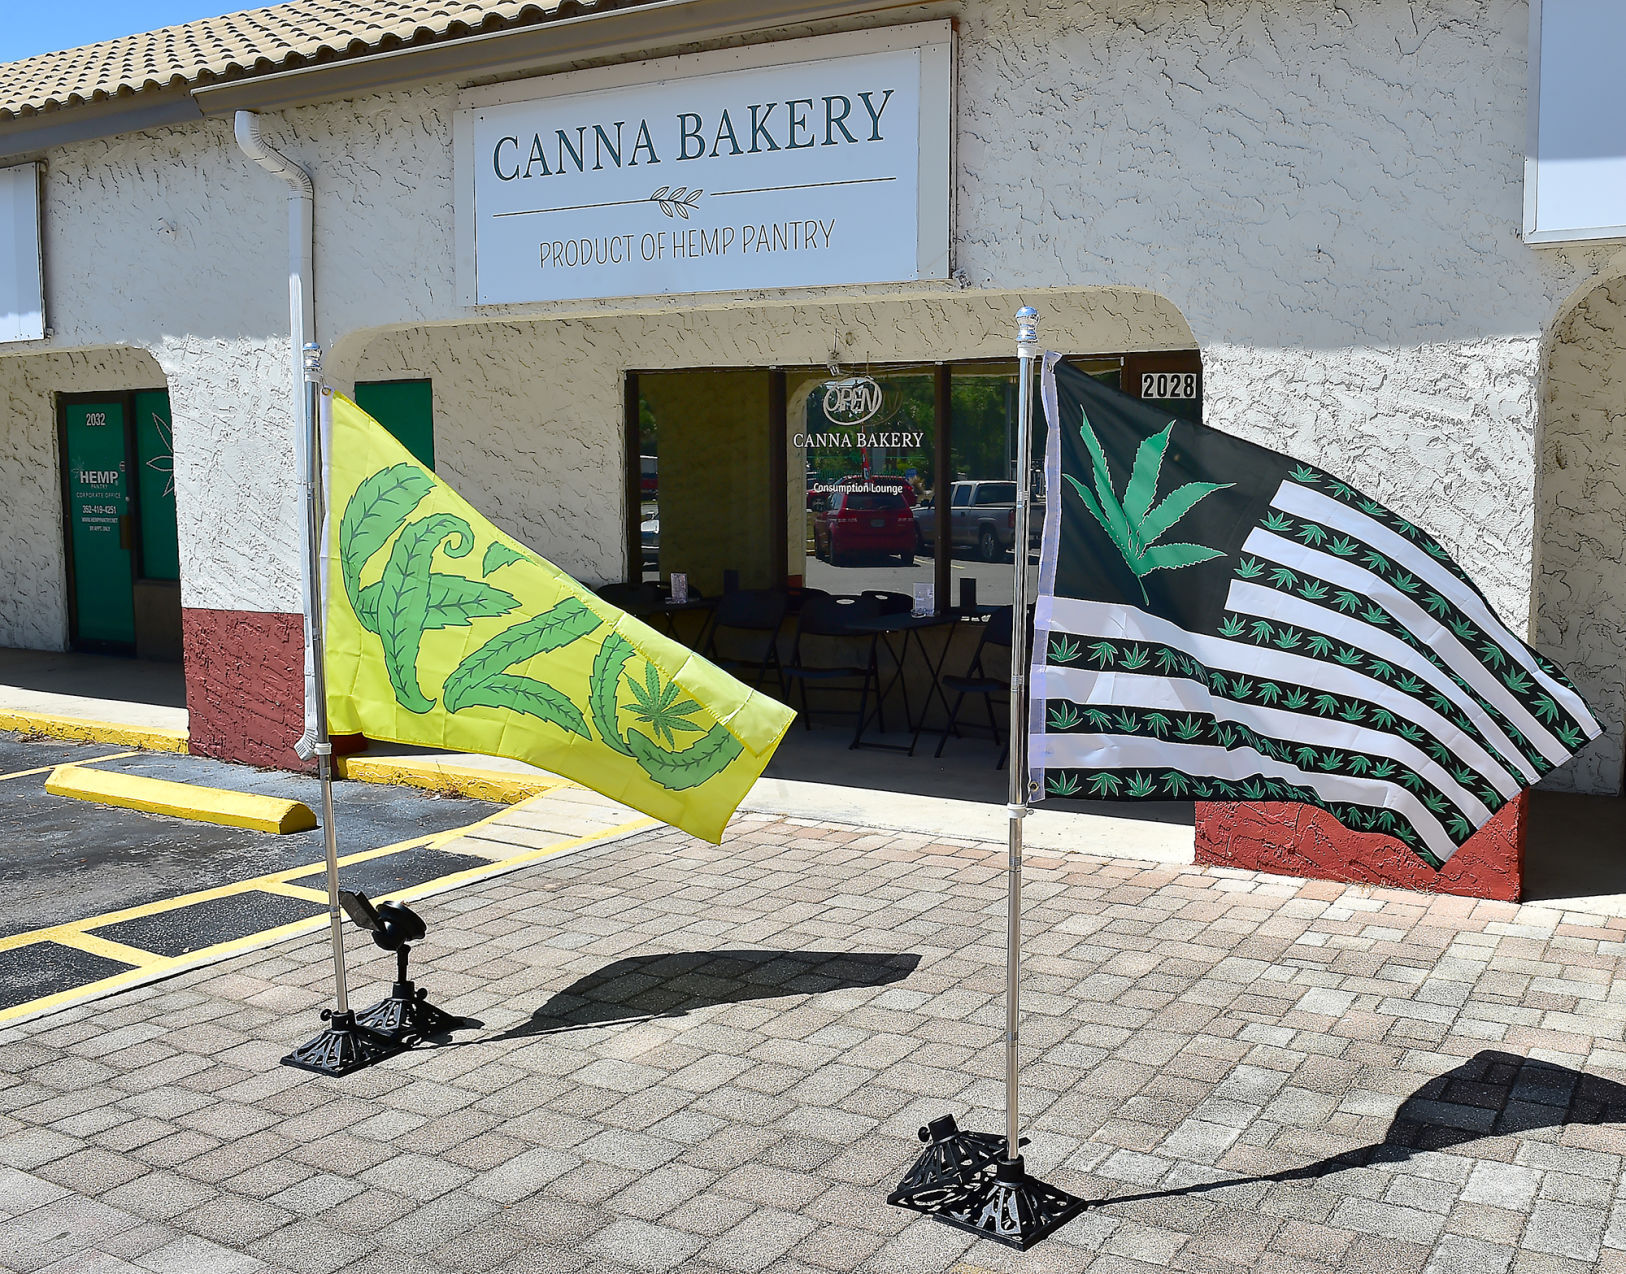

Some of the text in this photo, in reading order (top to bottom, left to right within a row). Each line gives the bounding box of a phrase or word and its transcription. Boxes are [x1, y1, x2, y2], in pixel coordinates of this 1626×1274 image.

[492, 88, 895, 182] CANNA BAKERY
[539, 217, 837, 269] PRODUCT OF HEMP PANTRY
[1143, 374, 1195, 398] 2028
[826, 387, 879, 412] OPEN
[86, 413, 106, 426] 2032
[793, 432, 924, 449] CANNA BAKERY
[80, 470, 119, 484] HEMP
[813, 482, 904, 496] Consumption Lounge
